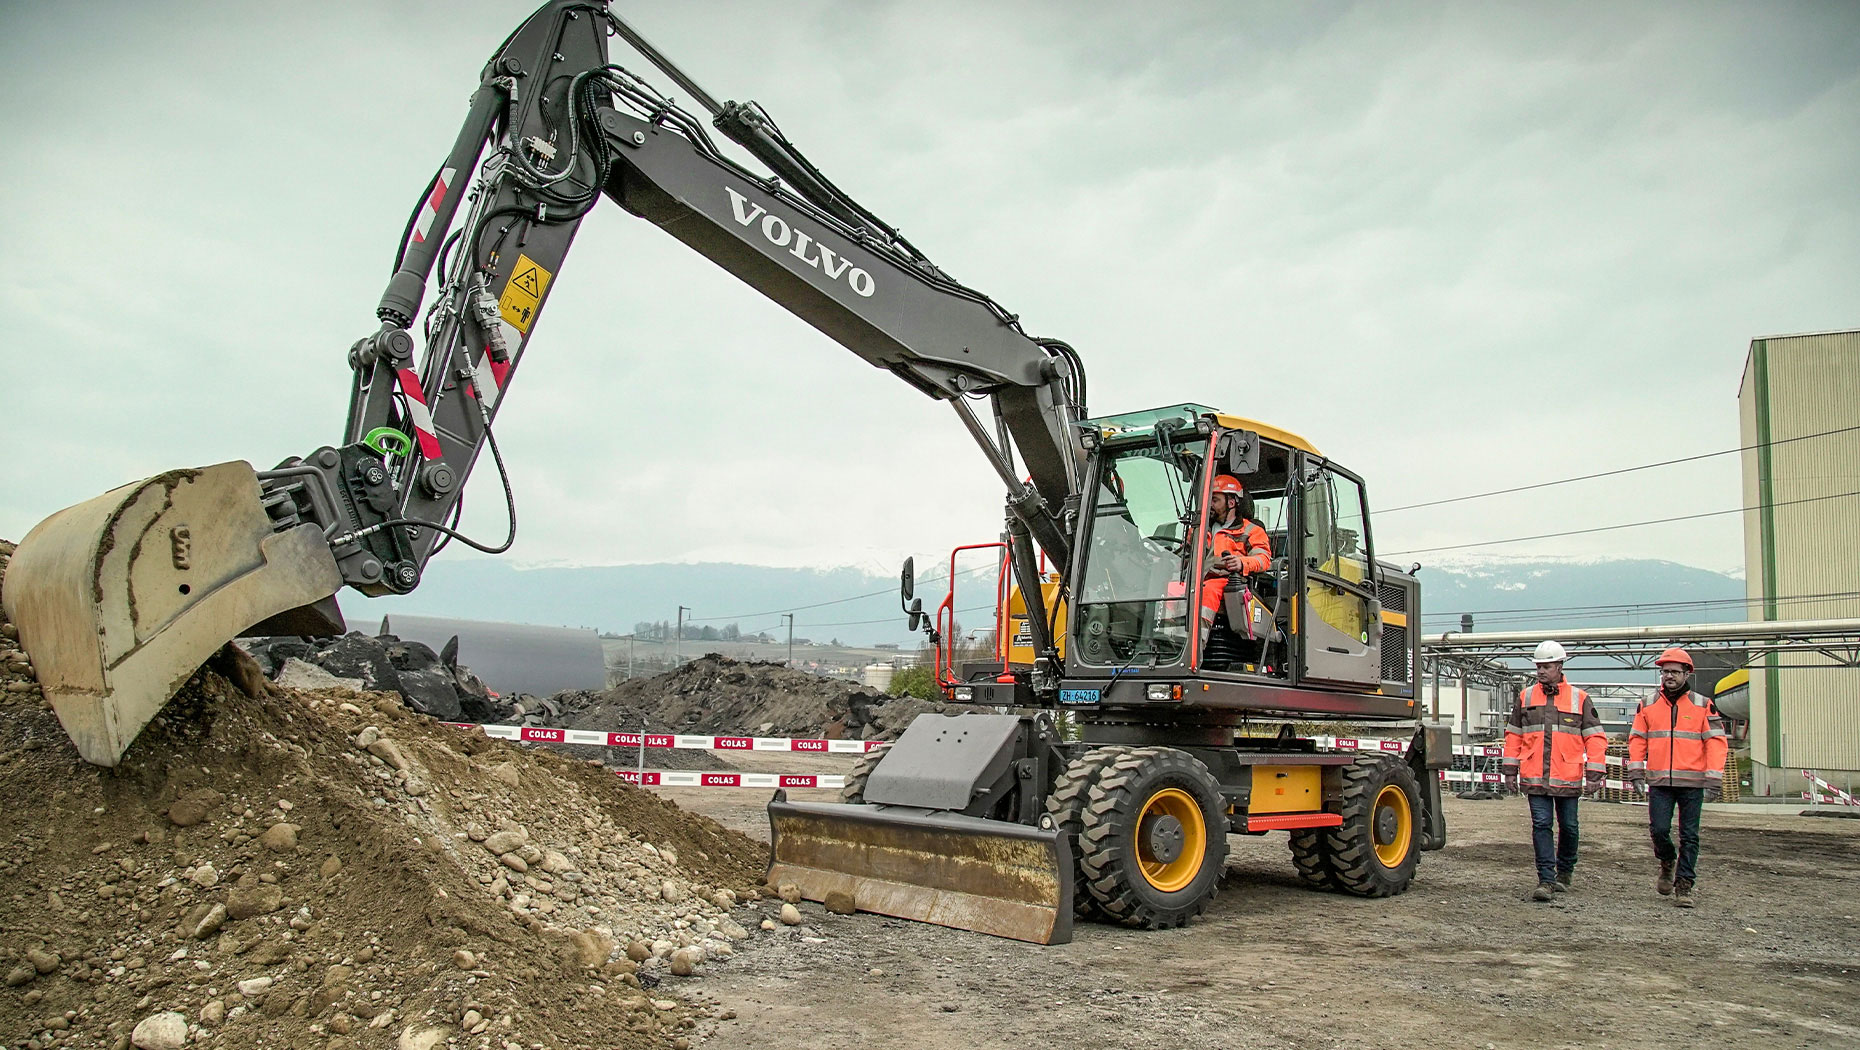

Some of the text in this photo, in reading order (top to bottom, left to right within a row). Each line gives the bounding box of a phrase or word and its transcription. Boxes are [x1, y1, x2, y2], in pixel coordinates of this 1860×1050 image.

[725, 186, 875, 297] VOLVO
[528, 730, 558, 739] COLAS
[721, 739, 747, 748] COLAS
[797, 742, 822, 750] COLAS
[708, 776, 734, 784] COLAS
